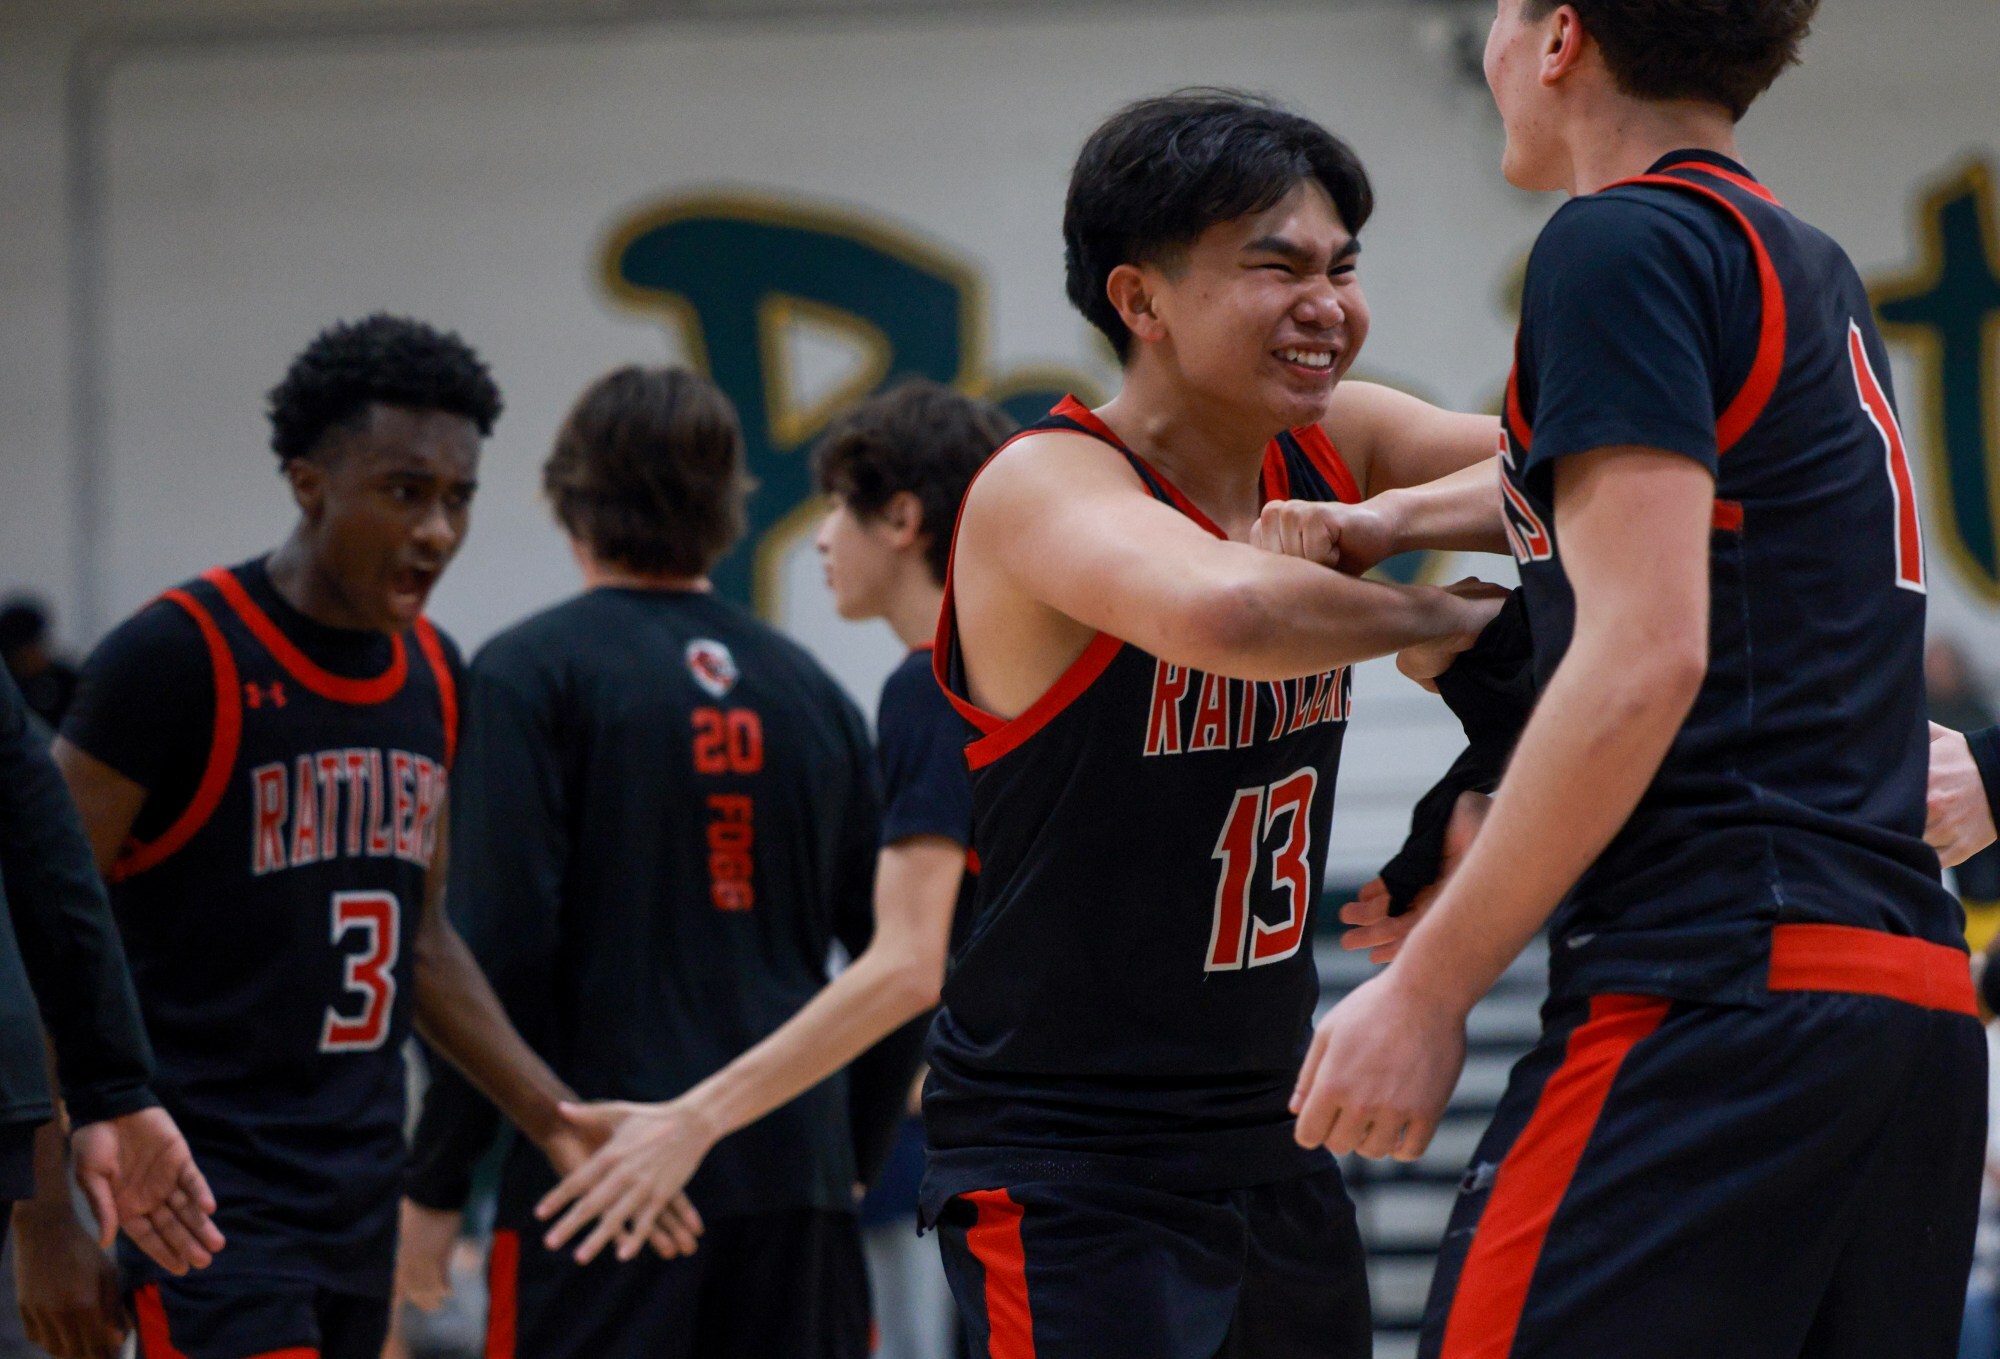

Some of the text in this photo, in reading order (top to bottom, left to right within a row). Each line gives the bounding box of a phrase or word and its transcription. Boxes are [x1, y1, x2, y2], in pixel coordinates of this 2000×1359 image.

[692, 706, 764, 774] 20
[1143, 658, 1352, 757] RATTLER
[1203, 765, 1319, 972] 13
[318, 890, 400, 1053] 3
